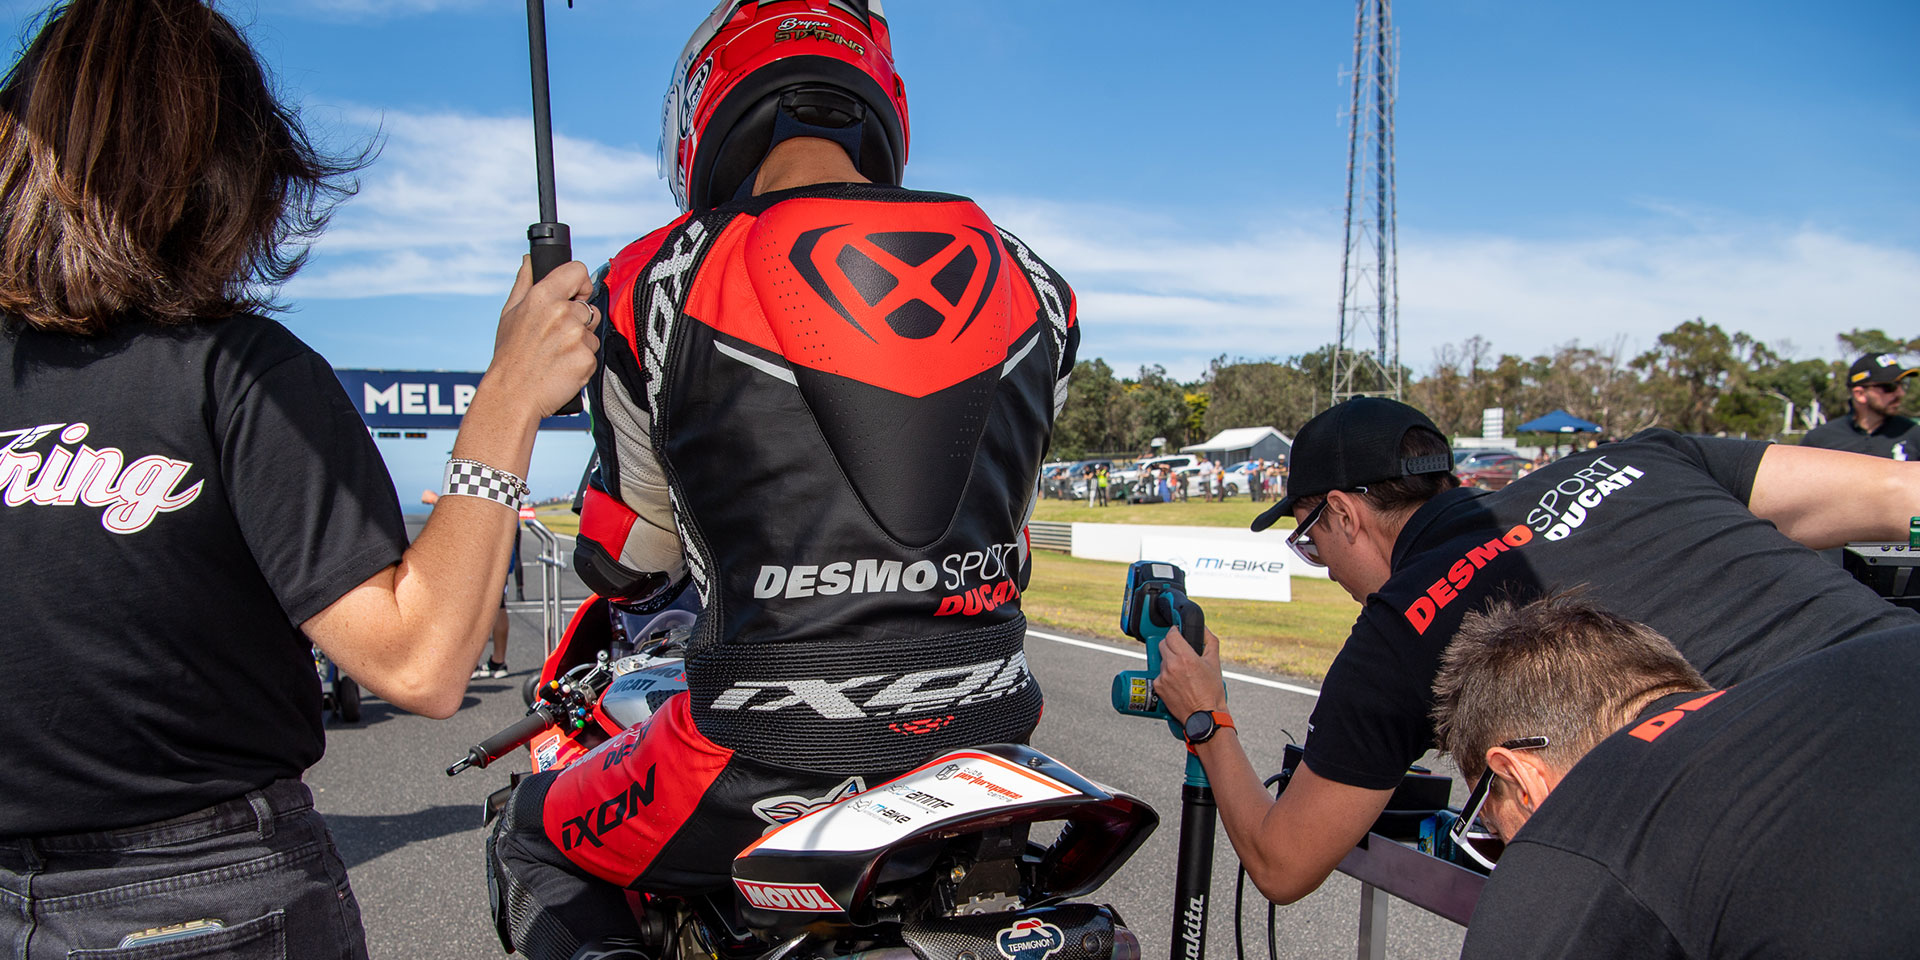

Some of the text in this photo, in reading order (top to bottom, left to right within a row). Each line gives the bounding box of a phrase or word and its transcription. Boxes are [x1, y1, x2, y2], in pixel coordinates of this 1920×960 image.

[778, 18, 832, 31] Bryan
[678, 52, 696, 84] LIFE
[364, 382, 478, 415] MELB
[0, 422, 205, 534] ring
[1543, 465, 1645, 542] DUCATI
[1404, 455, 1618, 636] DESMO SPORT
[754, 559, 938, 599] DESMO
[952, 771, 1023, 800] performance
[744, 884, 834, 909] MOTUL
[1183, 894, 1204, 960] akita
